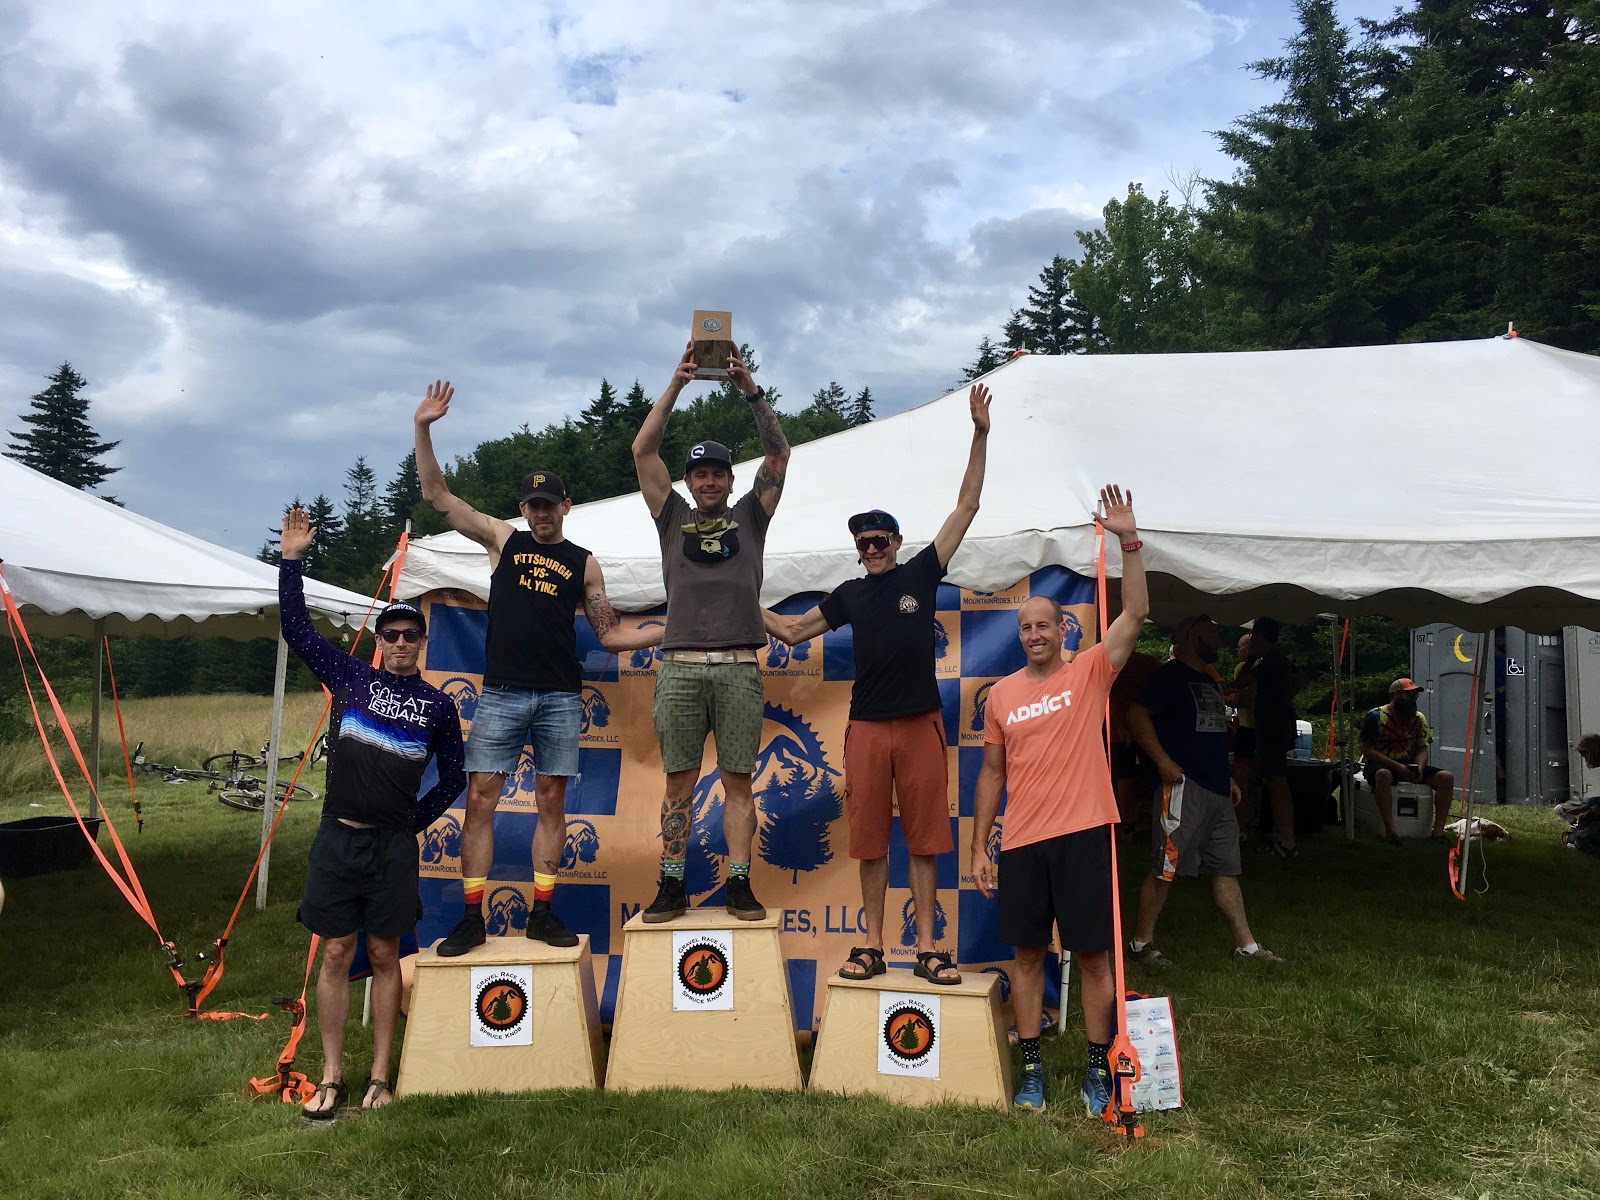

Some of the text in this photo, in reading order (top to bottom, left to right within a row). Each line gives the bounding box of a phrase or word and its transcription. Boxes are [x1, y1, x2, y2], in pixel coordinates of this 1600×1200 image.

[533, 475, 546, 489] P
[514, 553, 573, 580] PITTSBURGH
[1416, 634, 1426, 643] 157
[807, 668, 821, 676] LLC
[945, 665, 958, 673] LLC
[370, 681, 432, 715] GREAT
[1006, 690, 1072, 726] ADDICT
[606, 734, 620, 743] LLC
[594, 871, 608, 879] LLC
[678, 938, 700, 954] GRAVEL
[701, 936, 718, 944] RACE
[476, 971, 527, 990] GRAVEL RACE UP
[682, 990, 723, 1004] SPRUCE KNOB
[884, 999, 935, 1017] GRAVEL RACE UP
[480, 1026, 522, 1040] SPRUCE KNOB
[887, 1053, 929, 1069] SPRUCE KNOB
